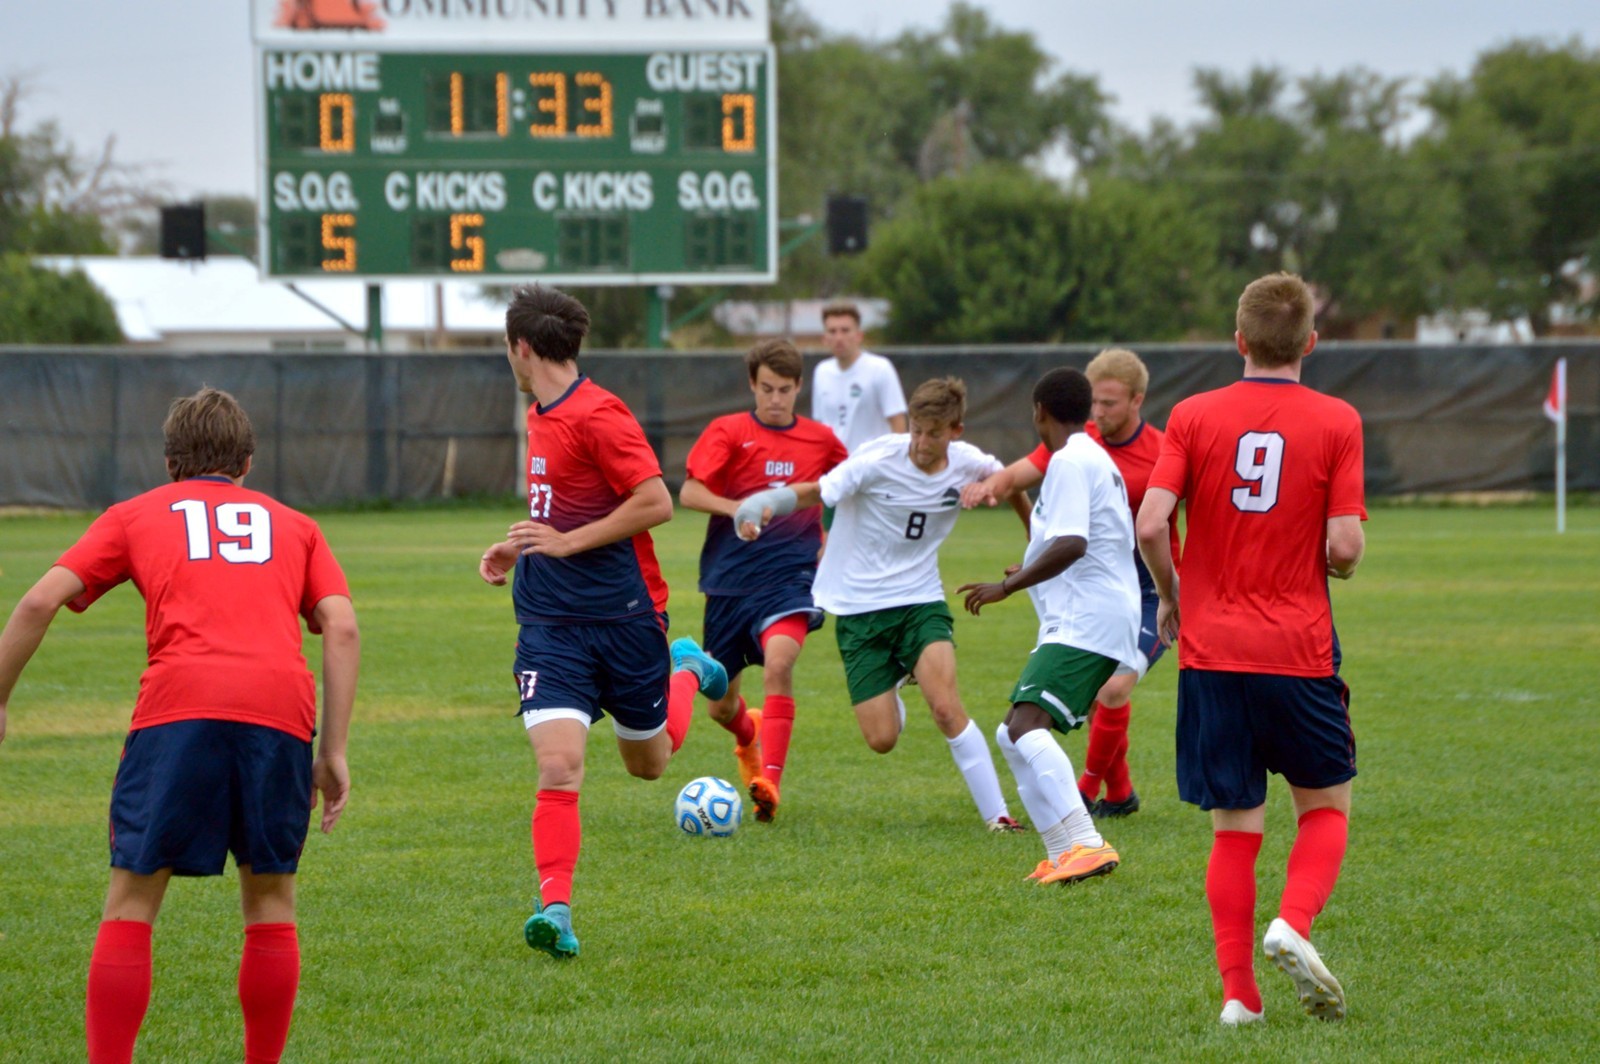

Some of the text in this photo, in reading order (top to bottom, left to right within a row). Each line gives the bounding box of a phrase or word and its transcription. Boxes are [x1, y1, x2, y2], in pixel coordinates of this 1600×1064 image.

[643, 0, 753, 19] BANK
[266, 53, 380, 91] HOME
[646, 53, 763, 92] GUEST
[320, 94, 355, 153] 0
[450, 72, 612, 137] 11:33
[722, 94, 755, 153] 0
[385, 171, 506, 211] C KICKS
[532, 171, 654, 211] C KICKS
[321, 214, 356, 271] 5
[450, 214, 485, 271] 5
[765, 460, 794, 476] DBU
[1231, 431, 1285, 513] 9
[529, 483, 552, 518] 27
[170, 499, 272, 565] 19
[905, 511, 927, 541] 8
